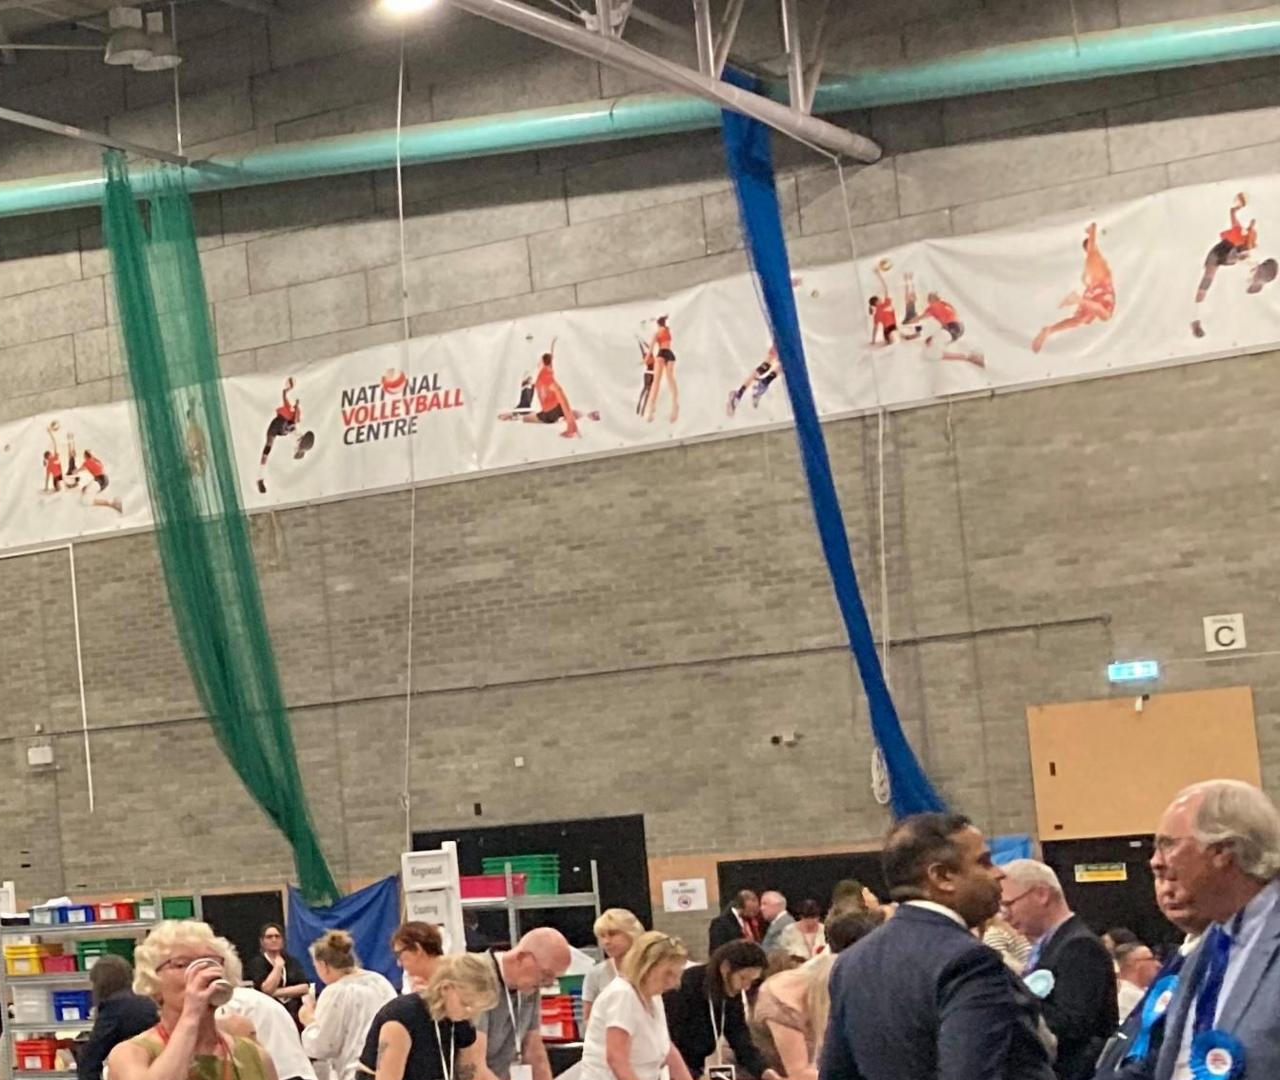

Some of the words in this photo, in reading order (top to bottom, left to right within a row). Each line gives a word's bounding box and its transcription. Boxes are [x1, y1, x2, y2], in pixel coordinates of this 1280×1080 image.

[341, 388, 464, 426] VOLLEYBALL
[343, 416, 418, 445] CENTRE
[1214, 625, 1236, 647] C
